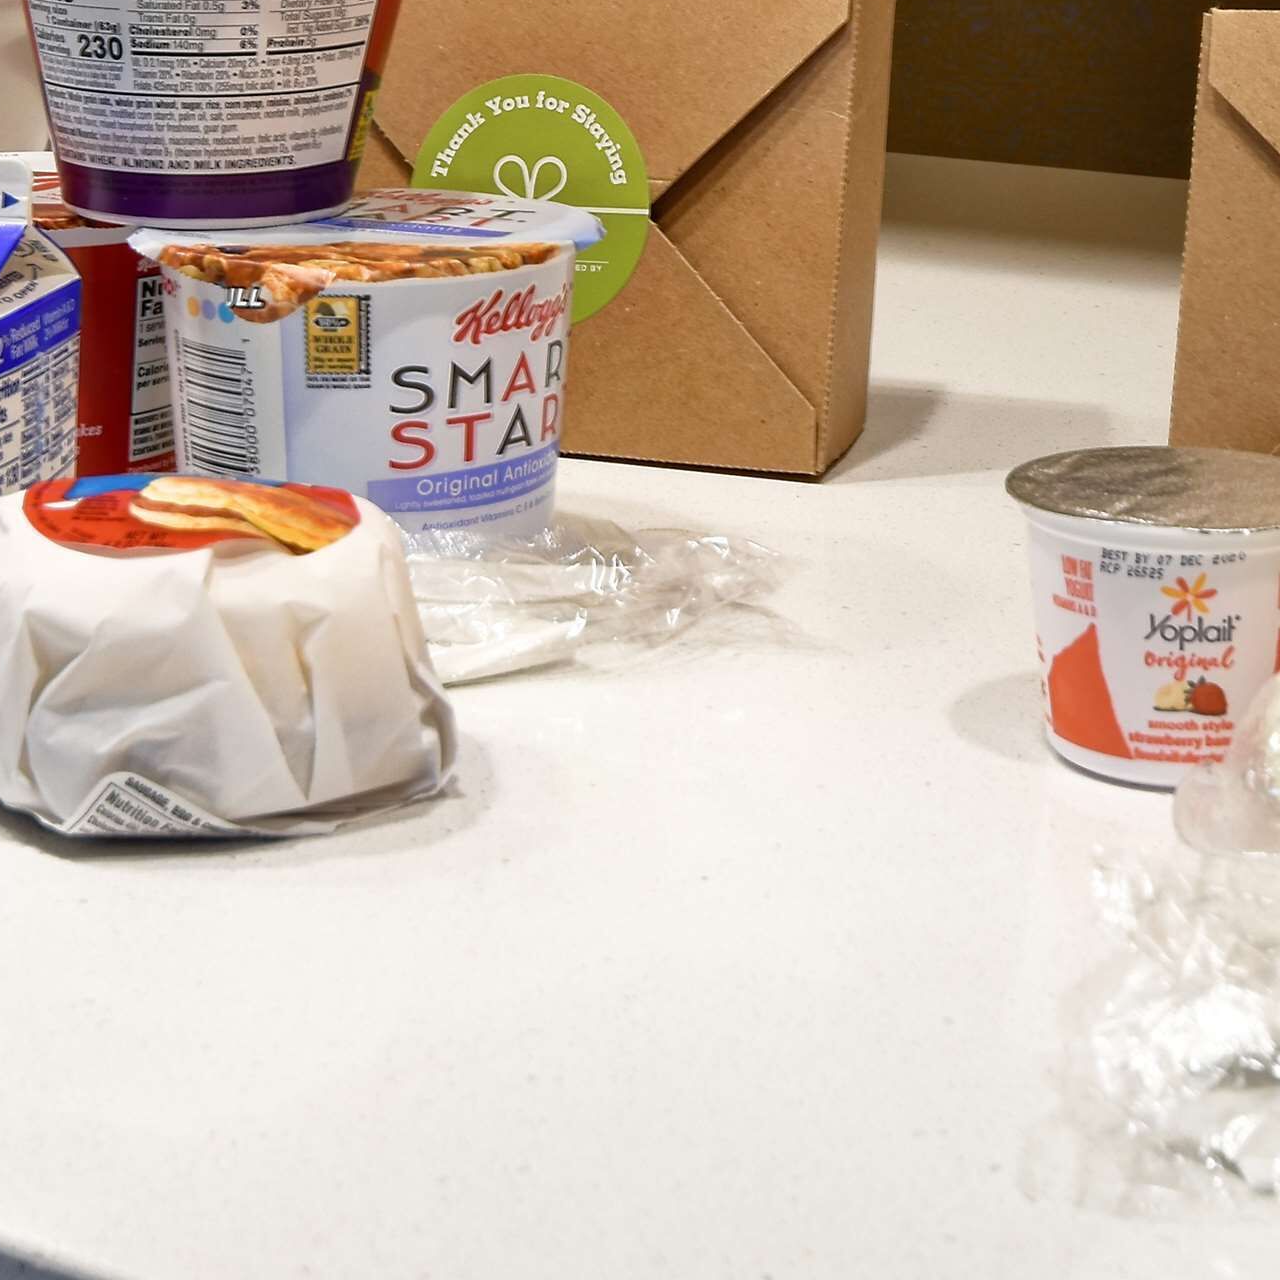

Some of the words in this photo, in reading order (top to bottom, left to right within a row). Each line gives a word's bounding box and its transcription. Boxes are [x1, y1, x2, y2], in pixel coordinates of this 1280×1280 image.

[128, 25, 193, 37] Cholesterol
[77, 33, 123, 61] 230
[130, 39, 170, 49] Sodium
[430, 109, 486, 179] Thank
[484, 93, 530, 117] You
[535, 90, 570, 114] for
[570, 103, 628, 185] Staying
[14, 281, 39, 300] OPEN
[416, 470, 499, 496] Original
[1100, 546, 1129, 561] BEST
[1134, 551, 1149, 565] BY
[1179, 554, 1203, 567] DEC
[1144, 612, 1235, 651] Yoplait
[1144, 645, 1236, 682] Original
[1148, 719, 1200, 731] smooth
[1202, 719, 1236, 733] style
[1128, 731, 1203, 750] strawberry
[104, 789, 161, 828] Nutrition
